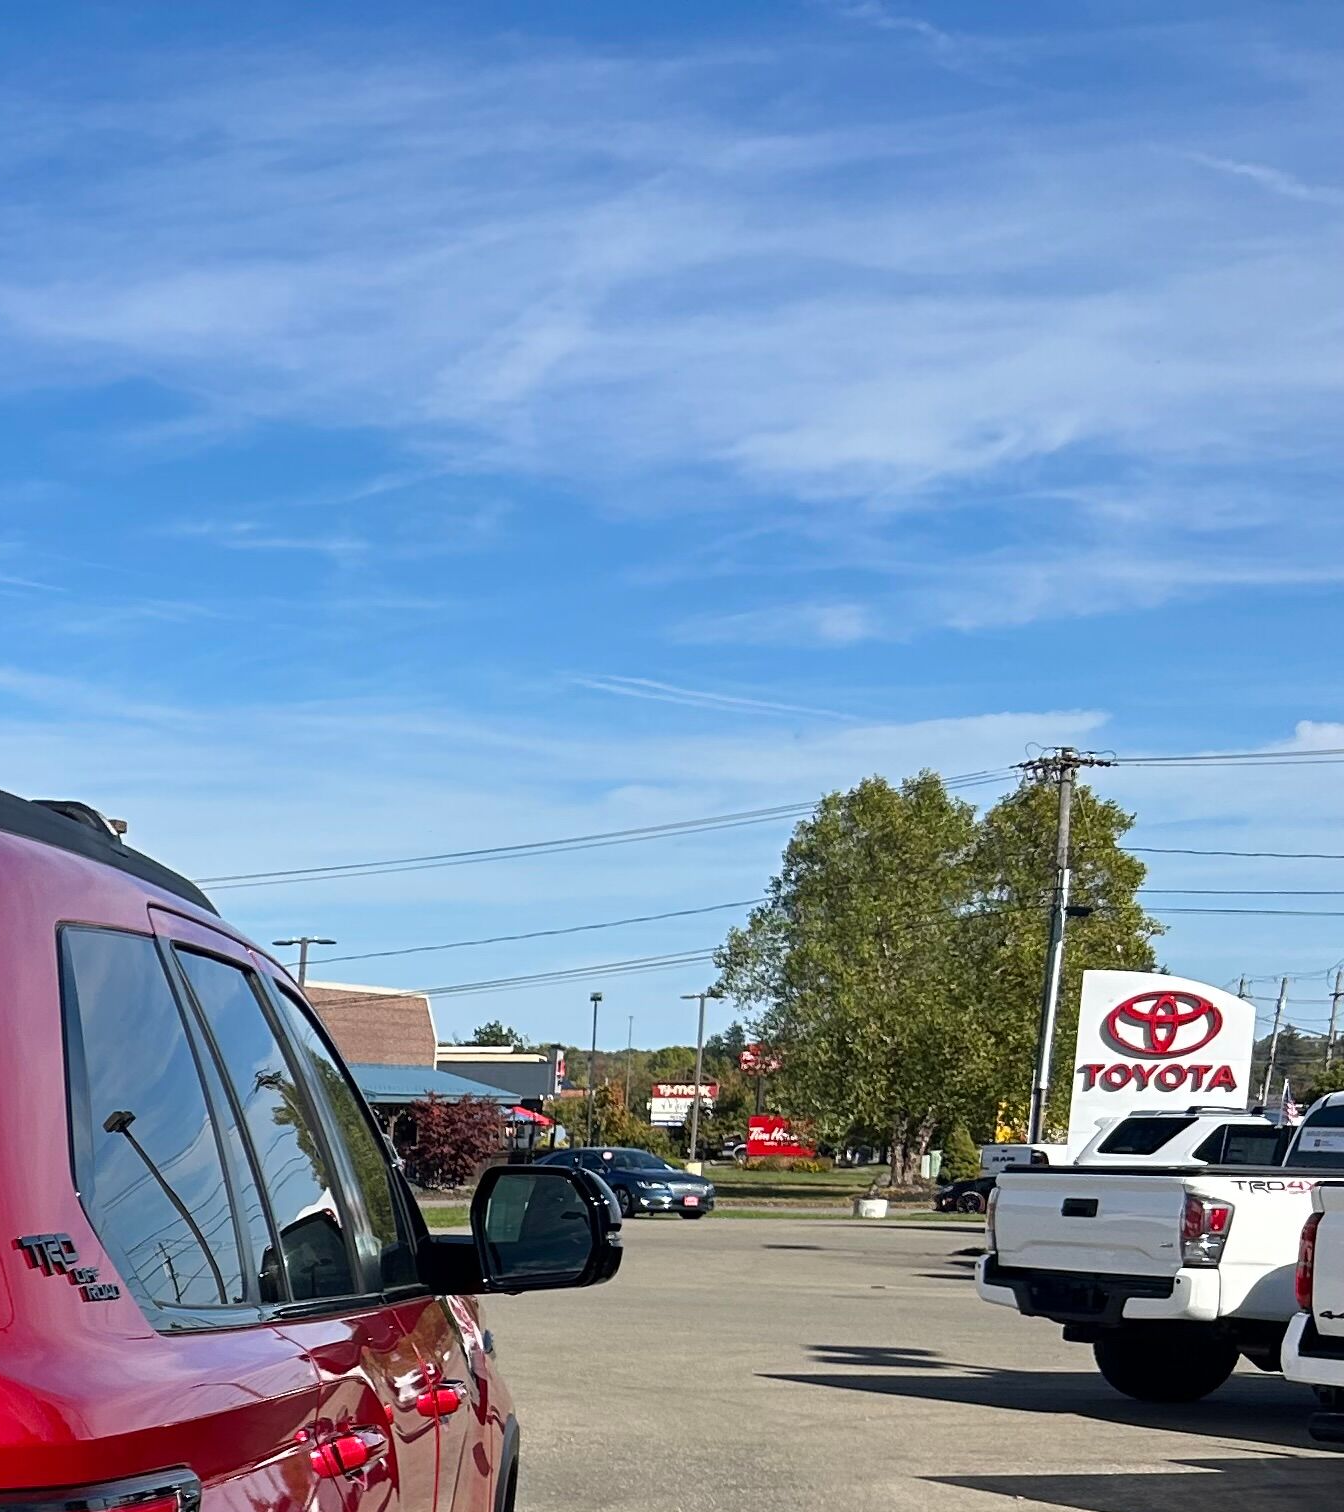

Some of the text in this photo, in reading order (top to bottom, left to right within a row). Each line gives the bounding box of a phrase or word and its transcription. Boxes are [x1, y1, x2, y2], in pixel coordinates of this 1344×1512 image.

[1079, 1063, 1237, 1092] TOYOTA
[1230, 1180, 1285, 1194] TRD
[11, 1232, 79, 1277] TRD
[68, 1266, 100, 1286] OFF
[79, 1283, 121, 1303] ROAD
